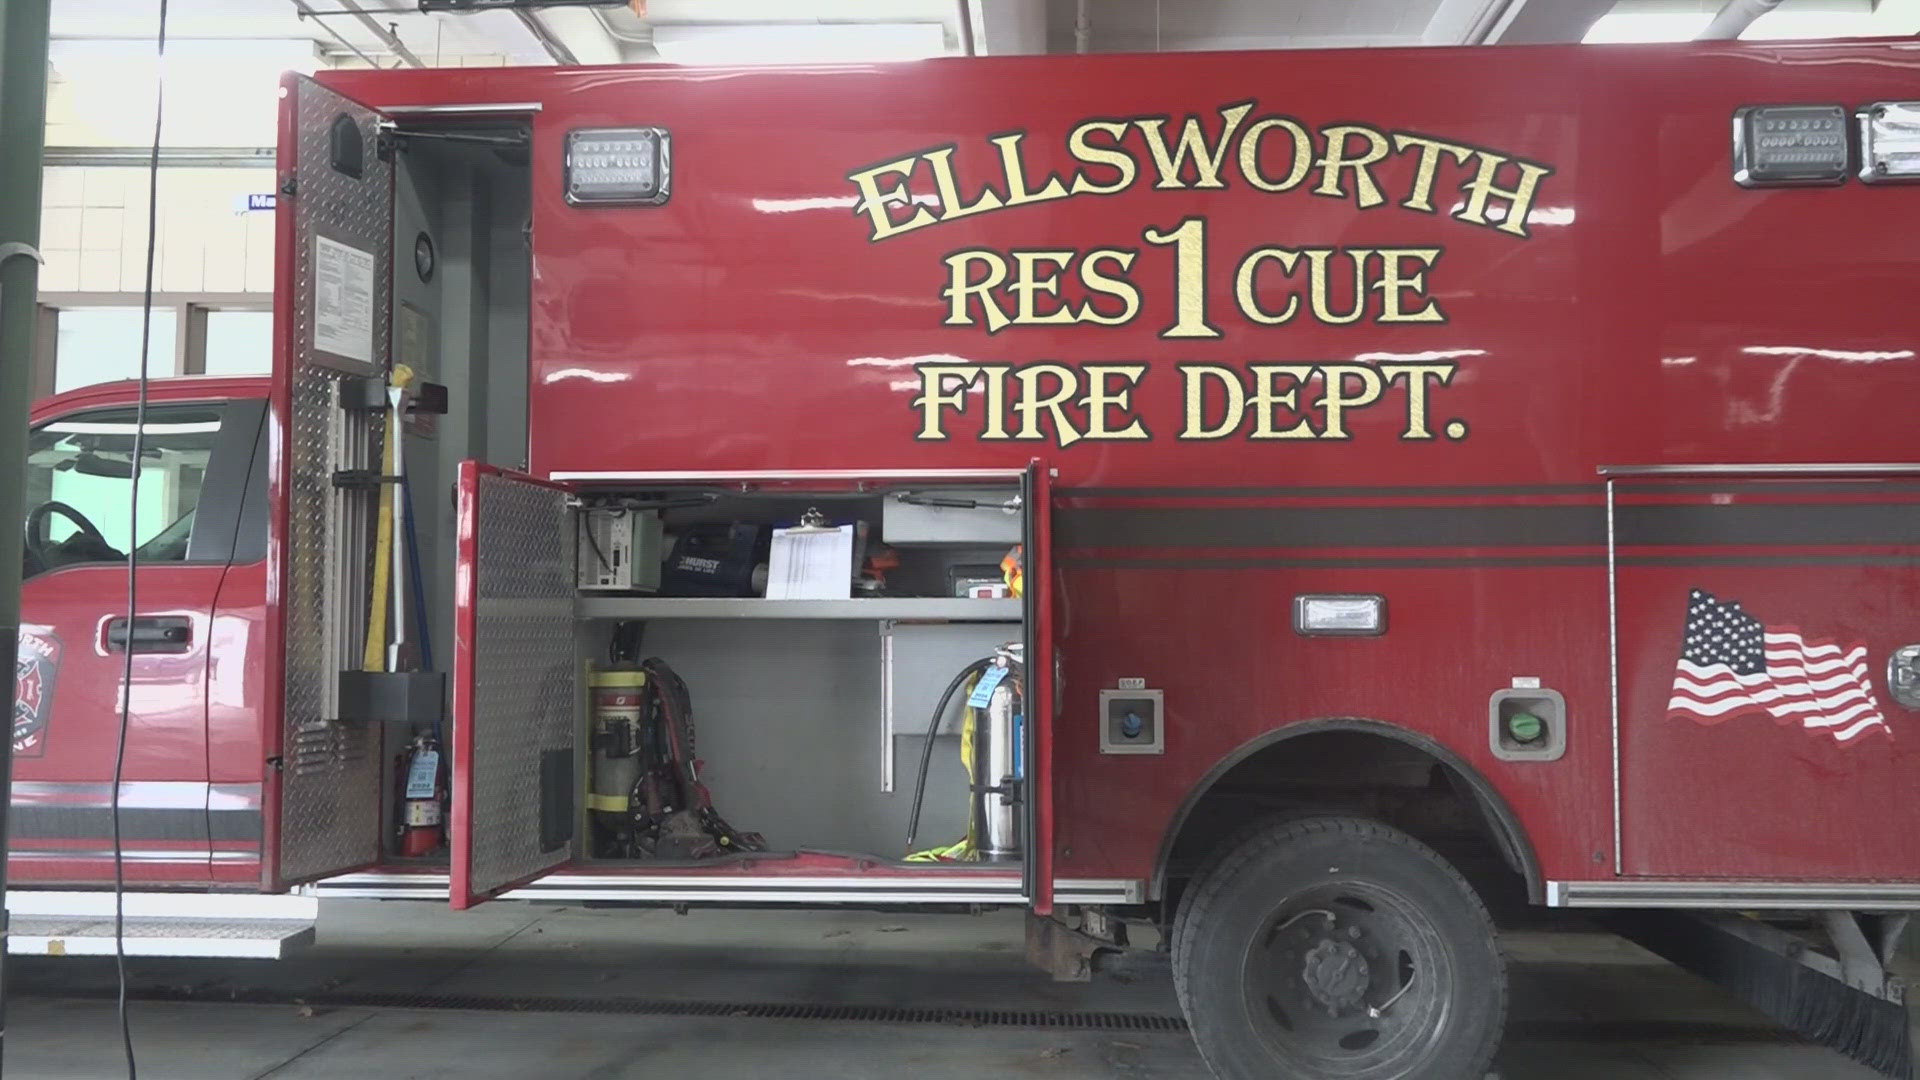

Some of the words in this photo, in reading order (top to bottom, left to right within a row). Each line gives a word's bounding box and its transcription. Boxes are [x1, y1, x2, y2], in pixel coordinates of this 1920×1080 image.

[849, 103, 1550, 242] ELLSWORTH
[911, 364, 1149, 447] FIRE
[1180, 364, 1466, 440] DEPT.
[685, 556, 720, 570] HURST
